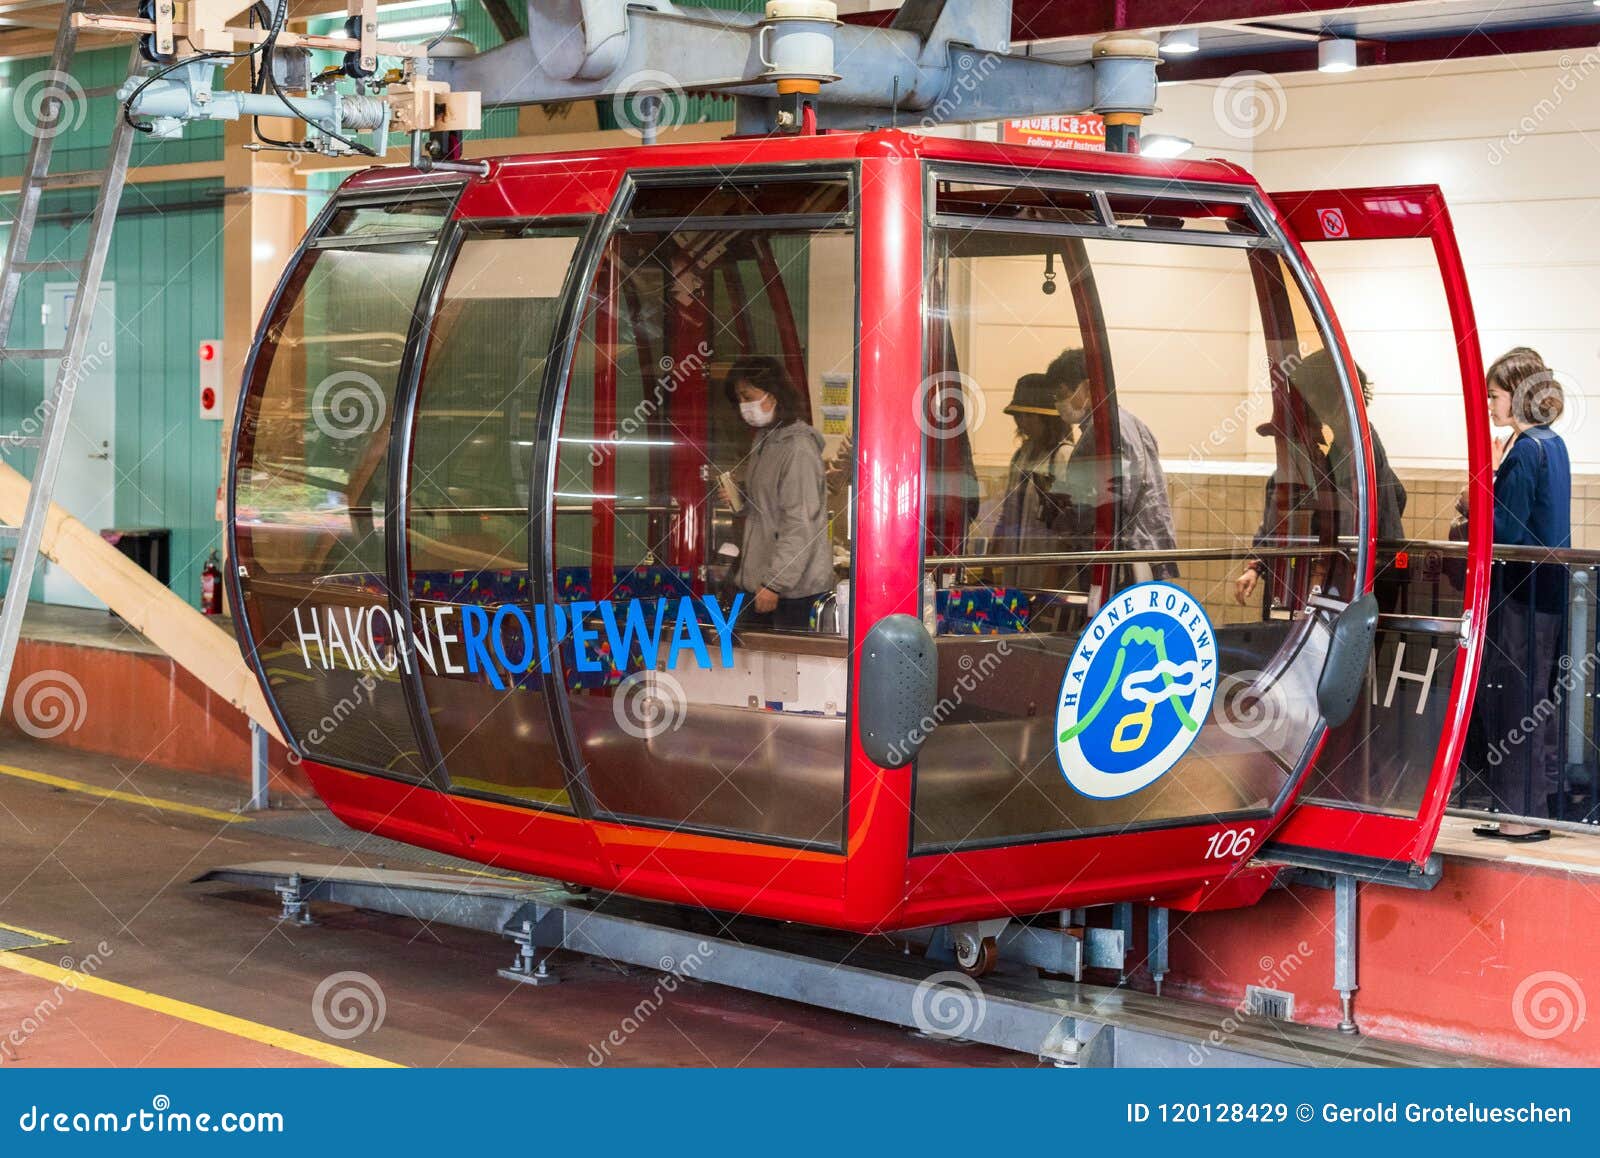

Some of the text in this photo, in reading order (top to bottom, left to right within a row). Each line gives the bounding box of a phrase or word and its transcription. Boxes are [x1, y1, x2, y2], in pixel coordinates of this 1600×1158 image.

[1027, 136, 1053, 148] Follow
[1054, 138, 1073, 150] Staff
[293, 592, 745, 690] HAKONE ROPEWAY
[1063, 590, 1213, 707] HAKONE ROPEWAY
[1204, 827, 1255, 859] 106
